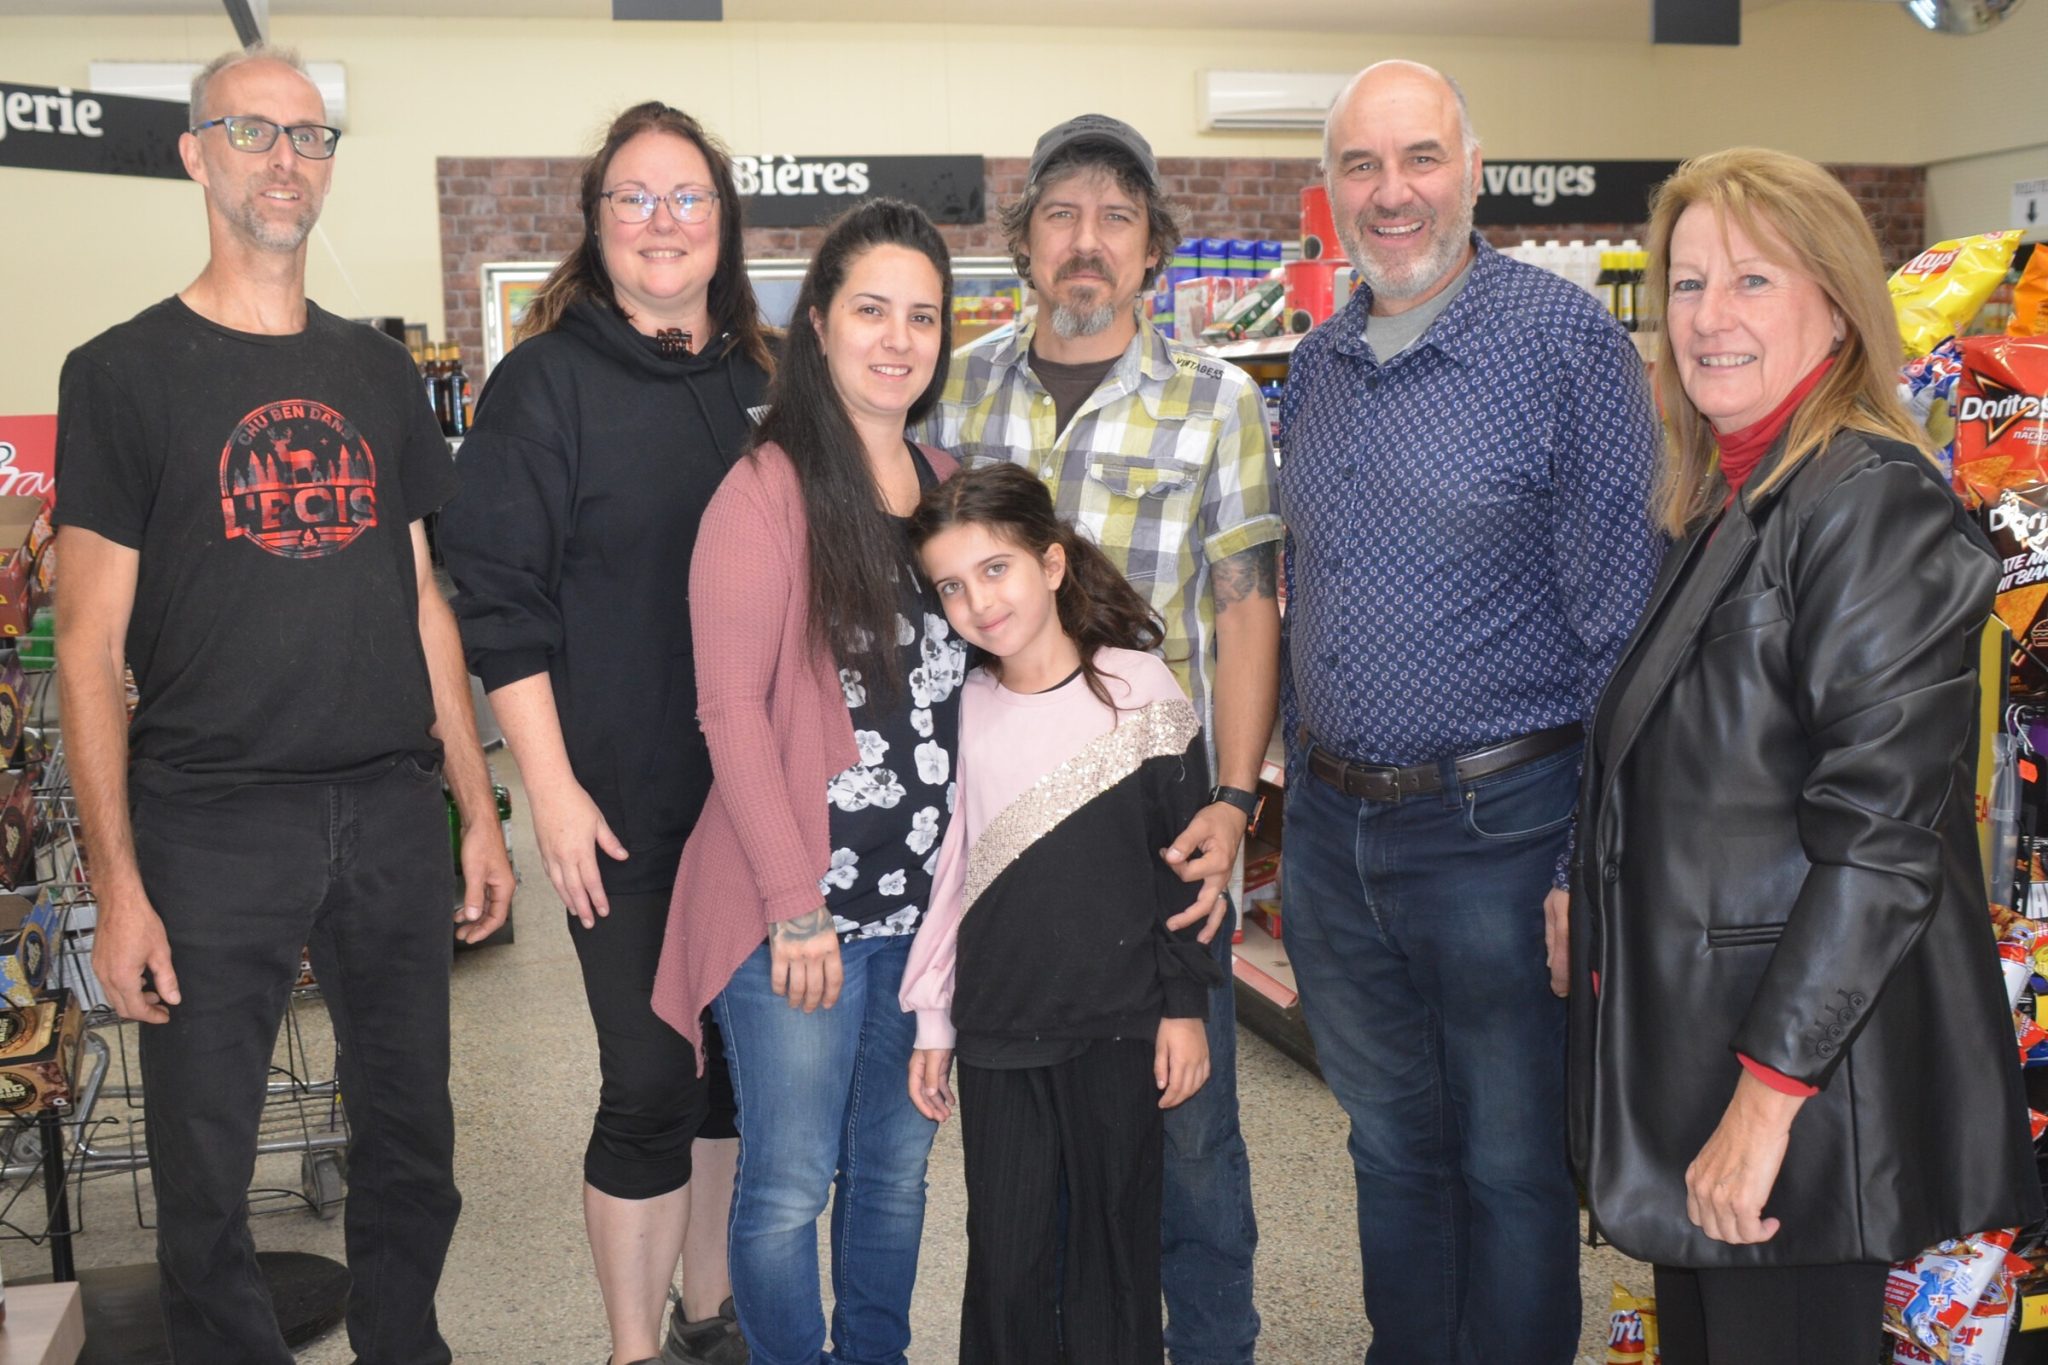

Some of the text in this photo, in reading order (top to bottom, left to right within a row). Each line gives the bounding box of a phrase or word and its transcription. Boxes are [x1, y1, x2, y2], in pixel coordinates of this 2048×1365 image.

[0, 86, 104, 141] erie
[732, 153, 870, 196] Bières
[1479, 164, 1596, 207] vages
[238, 405, 355, 446] CHU BEN DANS
